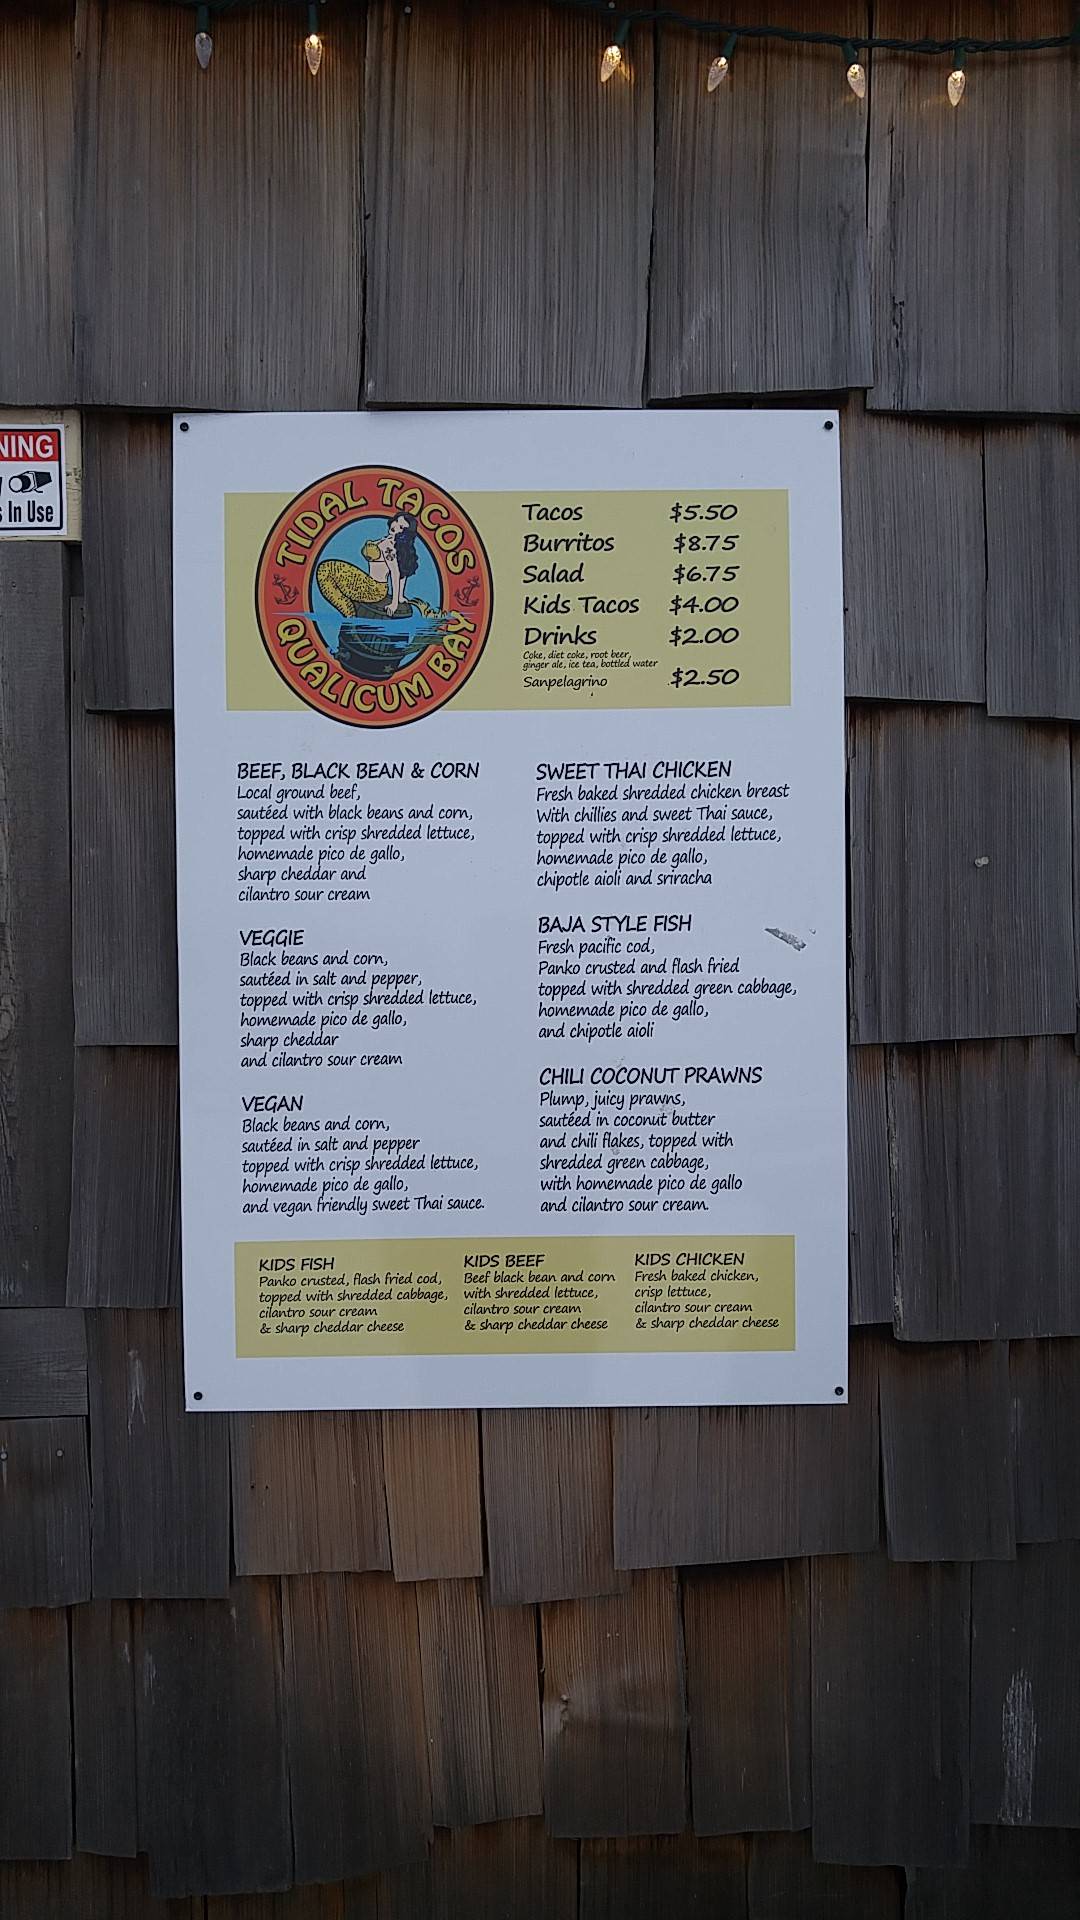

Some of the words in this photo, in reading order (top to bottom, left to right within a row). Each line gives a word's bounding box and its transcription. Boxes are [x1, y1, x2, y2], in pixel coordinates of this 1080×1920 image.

[8, 500, 22, 523] In
[27, 500, 54, 523] Use
[522, 504, 583, 520] Tacos
[670, 502, 738, 523] $5.50
[276, 481, 367, 567] TIDAL
[377, 478, 474, 575] TACOS
[524, 532, 614, 552] Burritos
[673, 533, 740, 554] $8.75
[523, 562, 584, 583] Salad
[672, 564, 740, 584] $6.75
[524, 594, 570, 614] Kids
[578, 596, 639, 613] Tacos
[669, 595, 739, 616] $4.00
[524, 625, 597, 646] Drinks
[669, 626, 739, 647] $2.00
[277, 618, 433, 713] QUALICUM
[427, 610, 476, 680] BAY
[522, 660, 550, 671] ginger
[552, 660, 566, 669] ale,
[569, 660, 580, 668] ice
[582, 660, 598, 668] tea,
[601, 658, 630, 668] bottled
[523, 650, 546, 660] Coke,
[548, 650, 565, 660] diet
[567, 650, 588, 660] coke,
[591, 650, 608, 660] root
[611, 650, 631, 660] beer,
[524, 675, 607, 691] Sanpelagrino
[670, 668, 739, 688] $2.50
[238, 763, 285, 780] BEEF,
[292, 762, 350, 780] BLACK
[356, 762, 404, 780] BEAN
[411, 762, 425, 778] &
[430, 762, 479, 778] CORN
[536, 762, 600, 780] SWEET
[603, 762, 646, 780] THAI
[653, 760, 732, 778] CHICKEN
[238, 784, 272, 799] Local
[275, 784, 325, 804] ground
[330, 784, 360, 801] beef,
[537, 785, 573, 802] Fresh
[578, 784, 618, 800] baked
[622, 783, 686, 800] shredded
[691, 783, 742, 799] chicken
[747, 782, 790, 798] breast
[237, 804, 288, 820] sautéed
[293, 804, 324, 819] with
[328, 804, 362, 820] black
[367, 804, 404, 819] beans
[408, 804, 434, 819] and
[439, 809, 472, 820] corn,
[537, 807, 570, 823] With
[574, 806, 617, 822] chillies
[622, 805, 648, 821] and
[653, 807, 692, 821] sweet
[696, 804, 727, 820] Thai
[731, 808, 772, 821] sauce,
[237, 825, 285, 845] topped
[290, 825, 320, 840] with
[325, 825, 356, 844] crisp
[360, 824, 422, 840] shredded
[427, 824, 474, 840] lettuce,
[238, 845, 314, 860] homemade
[318, 845, 344, 865] pico
[350, 844, 366, 860] de
[369, 844, 404, 864] gallo,
[238, 866, 276, 886] sharp
[281, 865, 337, 880] cheddar
[340, 865, 366, 880] and
[537, 871, 589, 892] chipotle
[594, 870, 620, 886] aioli
[626, 870, 652, 885] and
[657, 869, 712, 885] sriracha
[239, 886, 290, 901] cilantro
[294, 890, 324, 901] sour
[328, 890, 370, 900] cream
[538, 916, 586, 934] BAJA
[591, 915, 647, 932] STYLE
[654, 914, 692, 932] FISH
[240, 929, 304, 947] VEGGIE
[539, 938, 574, 954] Fresh
[578, 937, 622, 958] pacific
[626, 937, 654, 954] cod,
[539, 959, 580, 975] Panko
[586, 958, 636, 974] crusted
[640, 958, 667, 974] and
[672, 957, 704, 974] flash
[708, 957, 740, 974] fried
[240, 970, 291, 986] sautéed
[296, 971, 309, 985] in
[313, 970, 337, 986] salt
[341, 970, 367, 985] and
[371, 974, 422, 990] pepper,
[240, 1032, 278, 1052] sharp
[284, 1031, 339, 1046] cheddar
[540, 1068, 584, 1086] CHILI
[590, 1067, 680, 1084] COCONUT
[685, 1066, 762, 1084] PRAWNS
[242, 1095, 303, 1113] VEGAN
[540, 1090, 589, 1111] Plump,
[590, 1090, 624, 1110] juicy
[629, 1094, 685, 1110] prawns,
[539, 1111, 591, 1127] sautéed
[596, 1112, 610, 1126] in
[614, 1112, 667, 1126] coconut
[672, 1110, 716, 1126] butter
[540, 1132, 566, 1148] and
[571, 1132, 597, 1148] chili
[603, 1132, 644, 1149] flakes,
[648, 1131, 697, 1152] topped
[702, 1132, 733, 1147] with
[540, 1153, 602, 1170] shredded
[606, 1158, 646, 1174] green
[650, 1152, 708, 1174] cabbage,
[243, 1198, 268, 1213] and
[273, 1202, 312, 1217] vegan
[317, 1196, 367, 1216] friendly
[372, 1196, 410, 1211] sweet
[414, 1195, 442, 1210] Thai
[447, 1199, 484, 1210] sauce.
[259, 1258, 295, 1272] KIDS
[301, 1257, 334, 1271] FISH
[464, 1255, 500, 1268] KIDS
[506, 1254, 545, 1267] BEEF
[635, 1253, 670, 1266] KIDS
[676, 1252, 744, 1266] CHICKEN
[260, 1275, 296, 1287] Panko
[301, 1273, 349, 1286] crusted,
[354, 1273, 380, 1286] flash
[385, 1272, 412, 1285] fried
[417, 1272, 442, 1285] cod,
[464, 1271, 491, 1284] Beef
[494, 1270, 524, 1283] black
[528, 1270, 557, 1282] bean
[561, 1270, 584, 1282] and
[588, 1274, 616, 1282] corn
[635, 1270, 666, 1282] Fresh
[671, 1269, 706, 1281] baked
[711, 1269, 758, 1282] chicken,
[259, 1290, 301, 1306] topped
[306, 1290, 333, 1302] with
[337, 1288, 392, 1301] shredded
[397, 1288, 448, 1303] cabbage,
[464, 1287, 491, 1299] with
[495, 1286, 550, 1299] shredded
[555, 1286, 598, 1299] lettuce,
[635, 1286, 663, 1302] crisp
[668, 1285, 711, 1298] lettuce,
[636, 1318, 647, 1328] &
[651, 1316, 685, 1332] sharp
[689, 1316, 739, 1328] cheddar
[742, 1316, 779, 1328] cheese
